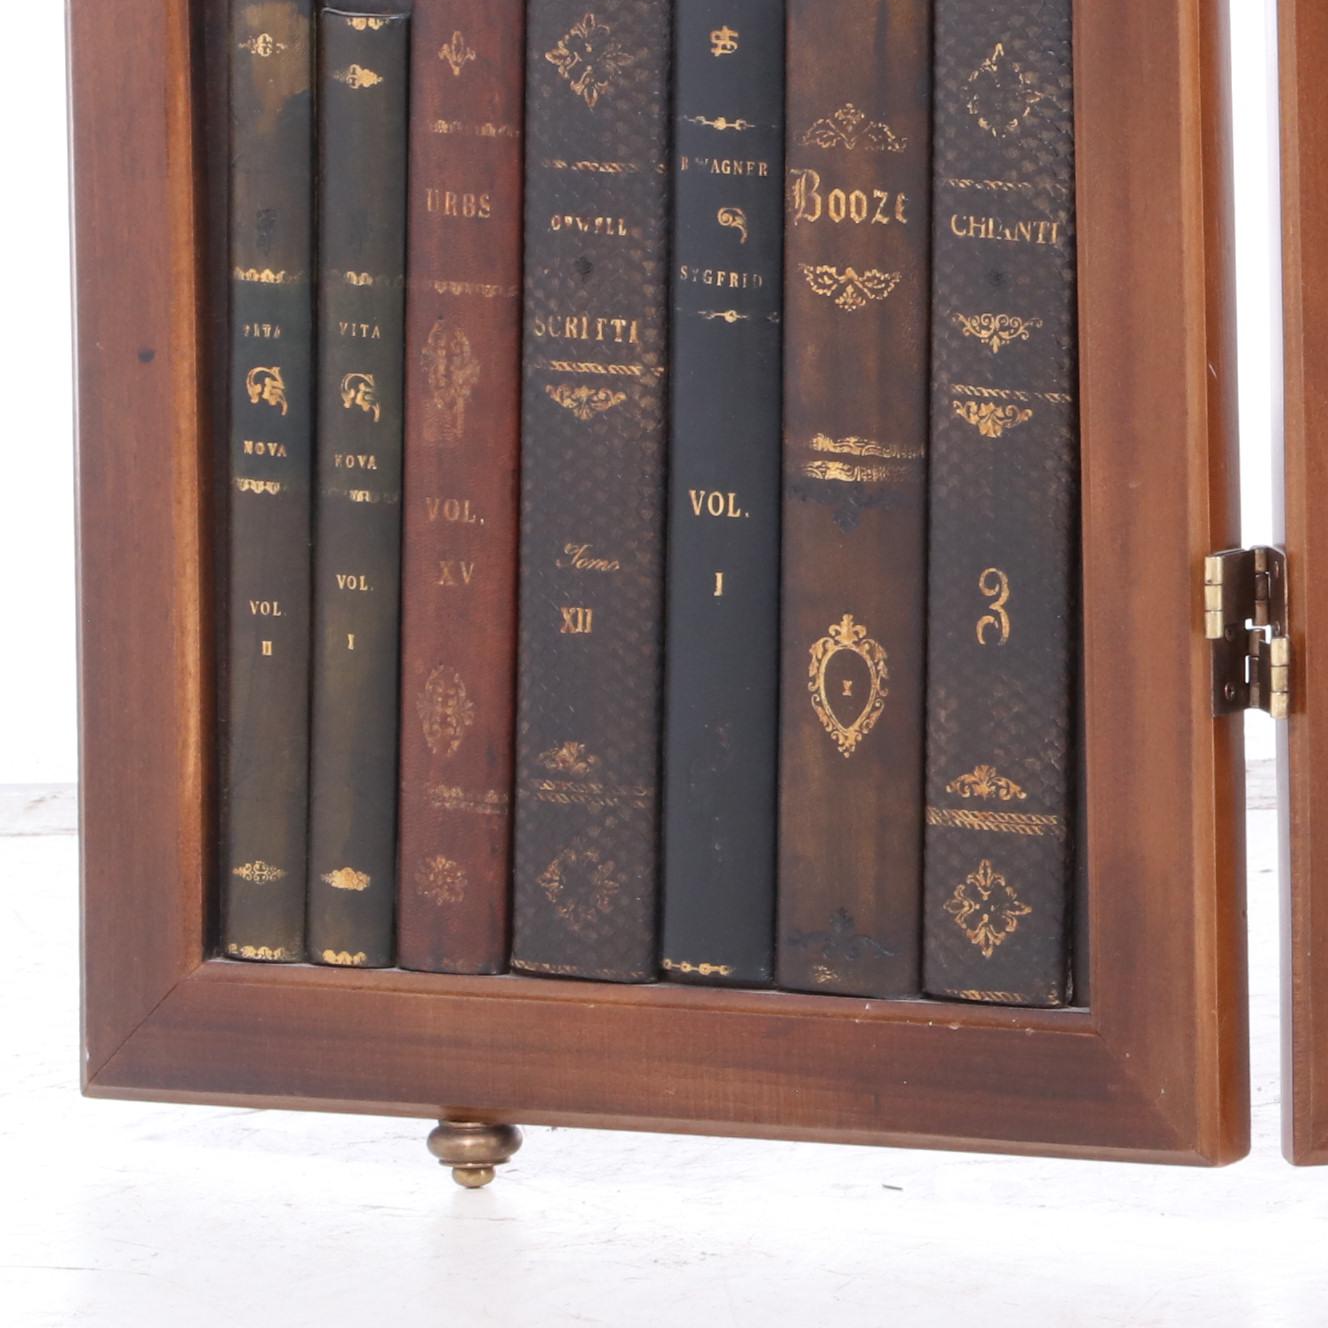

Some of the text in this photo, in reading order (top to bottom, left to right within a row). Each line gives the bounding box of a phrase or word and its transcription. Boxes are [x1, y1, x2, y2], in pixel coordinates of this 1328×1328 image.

[426, 188, 492, 219] URBS
[789, 168, 909, 226] Booze
[950, 214, 1060, 247] CHIANTI
[339, 321, 382, 340] VITA
[426, 497, 486, 526] VOL.
[688, 488, 751, 519] VOL.
[335, 573, 375, 592] VOL.
[438, 560, 476, 586] XV
[249, 599, 288, 617] VOL.
[560, 606, 593, 634] XII
[975, 567, 1010, 647] 3
